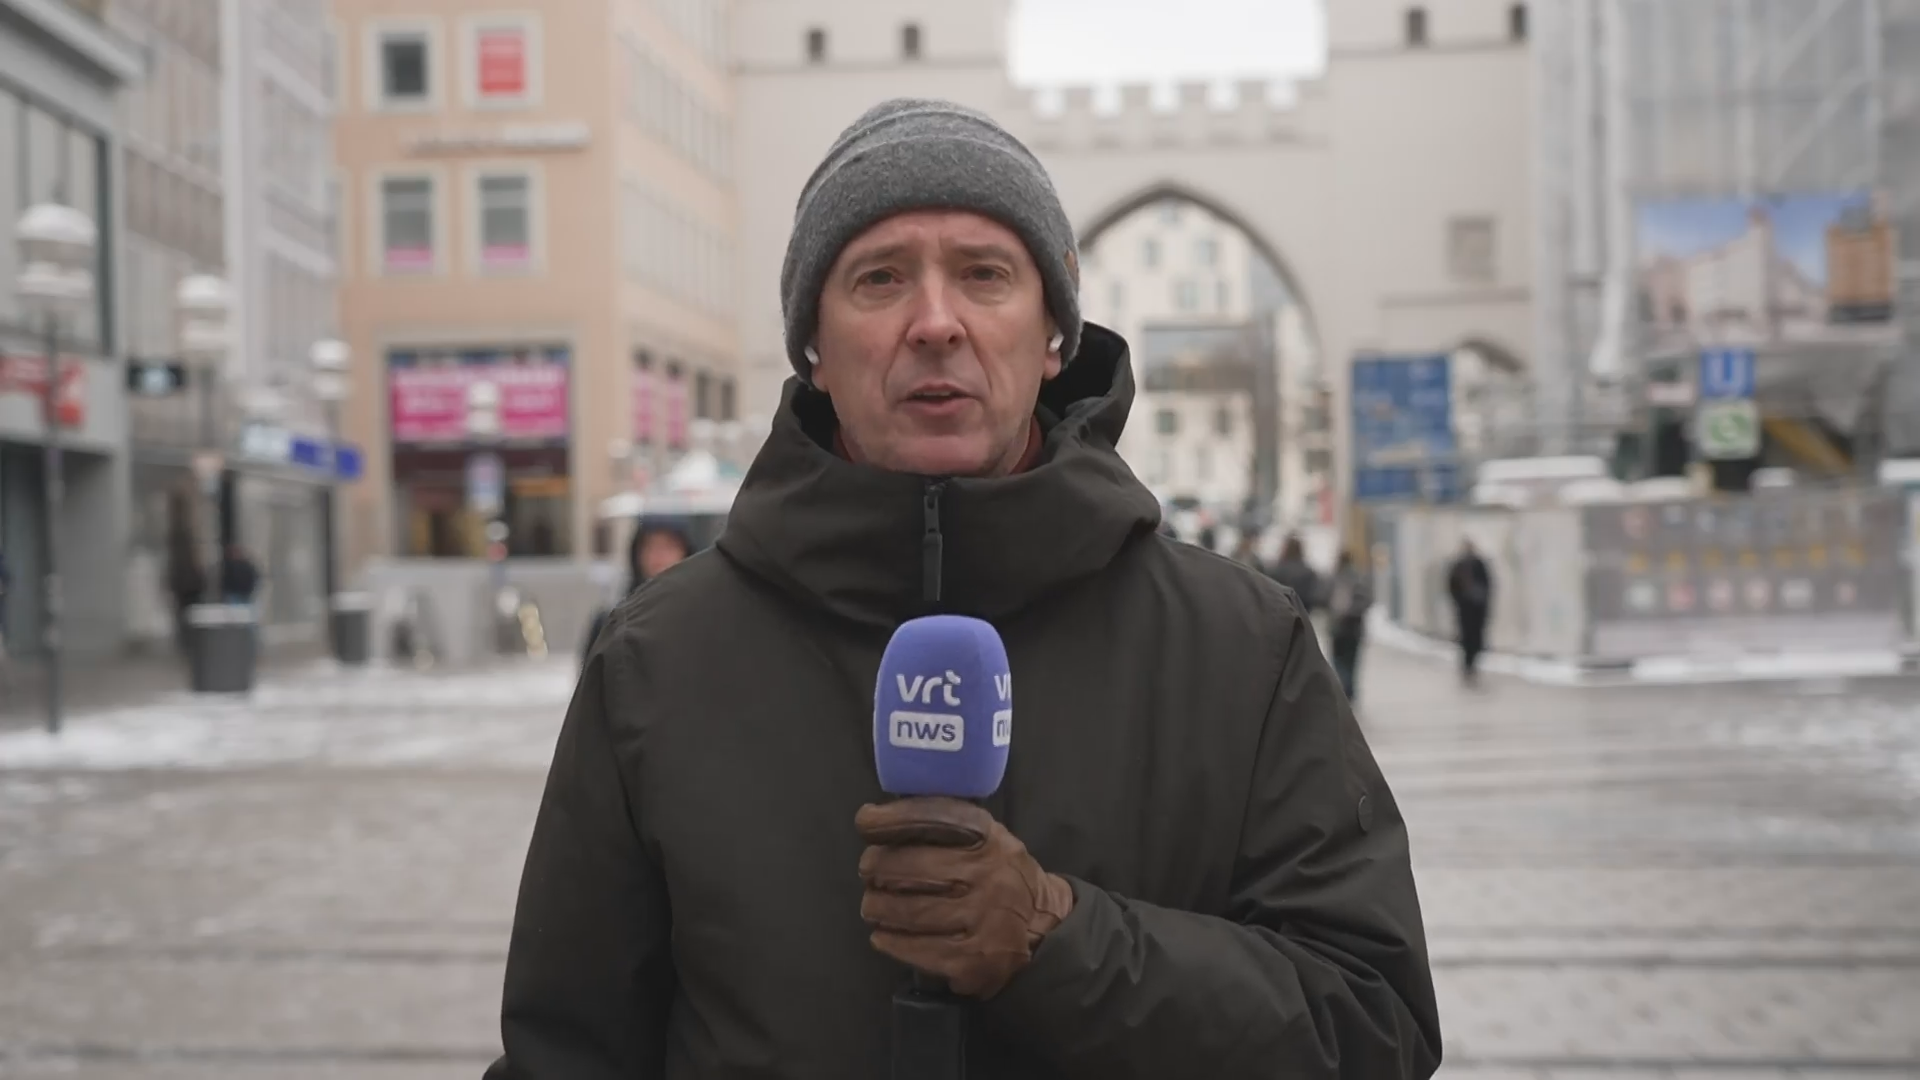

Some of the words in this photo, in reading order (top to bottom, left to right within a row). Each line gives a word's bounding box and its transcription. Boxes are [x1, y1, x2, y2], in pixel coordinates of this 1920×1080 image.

[1709, 351, 1745, 396] U
[896, 669, 961, 707] vrt
[897, 719, 956, 743] nws
